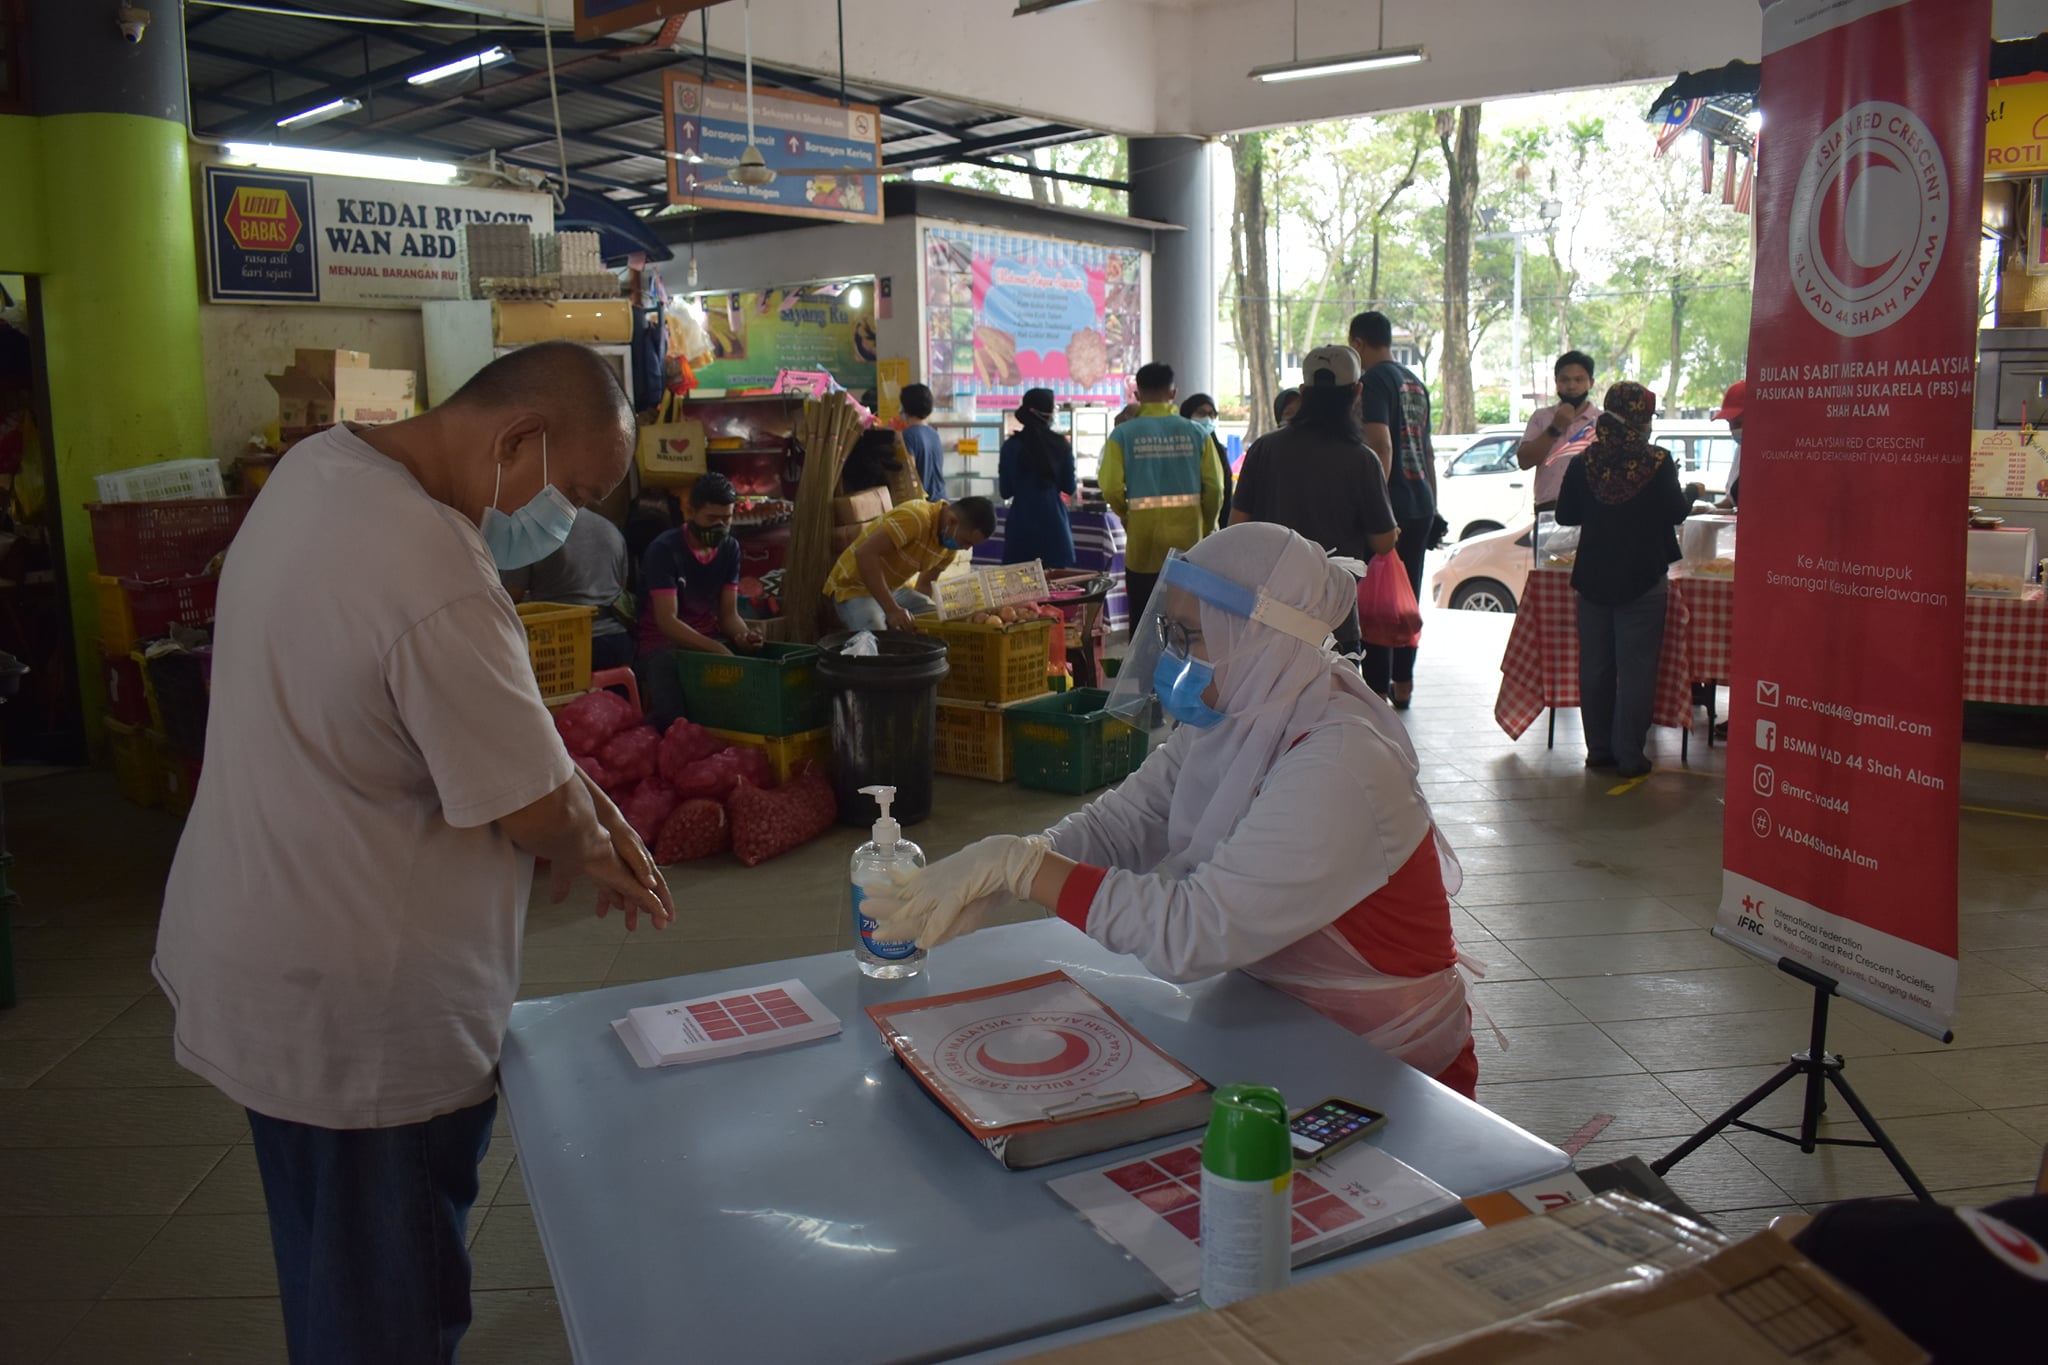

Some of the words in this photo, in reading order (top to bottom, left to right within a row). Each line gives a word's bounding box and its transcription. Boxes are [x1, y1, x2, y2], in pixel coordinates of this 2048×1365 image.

[731, 101, 760, 115] Mon
[701, 126, 747, 143] Barangan
[805, 141, 845, 157] Barangan
[846, 147, 873, 162] Kering
[1856, 112, 1883, 130] RED
[1887, 116, 1941, 202] CRESCENT
[1987, 144, 2042, 165] ROTI
[748, 185, 780, 200] Ringan
[337, 198, 427, 229] KEDAI
[325, 227, 392, 255] WAN
[400, 233, 457, 260] ABD
[244, 254, 267, 265] rasa
[269, 252, 288, 265] asli
[241, 265, 263, 278] kari
[265, 268, 292, 282] sejati
[328, 264, 379, 278] MENJUAL
[382, 268, 439, 281] BARANGAN
[1804, 279, 1834, 315] VAD
[1835, 309, 1849, 324] 44
[1851, 298, 1899, 326] SHAH
[1902, 234, 1939, 301] ALAM
[1759, 365, 1799, 382] BULAN
[1803, 363, 1839, 381] SABIT
[1841, 360, 1889, 378] MERAH
[1893, 356, 1970, 377] MALAYSIA
[1756, 387, 1804, 401] PASUKAN
[1807, 385, 1853, 399] BANTUAN
[1856, 382, 1923, 398] SUKARELA
[1927, 380, 1959, 399] (PBS)
[1961, 381, 1972, 395] 44
[1826, 404, 1850, 418] SHAH
[1852, 403, 1890, 417] ALAM
[1796, 436, 1844, 448] MALAYSIAN
[1846, 437, 1864, 449] RED
[1866, 437, 1926, 449] CRESCENT
[1760, 450, 1805, 461] VOLUNTARY
[1806, 451, 1821, 461] AID
[1869, 452, 1898, 464] (VAD)
[1901, 453, 1912, 463] 44
[1914, 453, 1939, 464] SHAH
[1940, 454, 1964, 465] ALAM
[1797, 554, 1814, 569] Ke
[1816, 557, 1840, 573] Arah
[1841, 561, 1913, 582] Memupuk
[1766, 570, 1827, 593] Semangat
[1829, 579, 1948, 607] Kesukarelawanan
[1785, 694, 1932, 737] mrc.vad44@gmail.com
[1783, 735, 1818, 757] BSMM
[1820, 746, 1842, 765] VAD
[1845, 755, 1863, 770] 44
[1867, 758, 1902, 780] Shah
[1905, 768, 1945, 791] Alam
[1780, 780, 1850, 815] @mrc.vad44
[1777, 823, 1879, 871] VAD44ShahAlam
[863, 919, 879, 929] アル
[1737, 914, 1765, 936] IFRC
[1773, 906, 1819, 933] International
[1819, 926, 1863, 951] Federation
[1783, 922, 1798, 938] Red
[1799, 929, 1818, 946] Cross
[1818, 938, 1835, 954] and
[1836, 943, 1853, 961] Red
[1854, 953, 1895, 976] Crescent
[1895, 969, 1935, 993] Societies
[1821, 955, 1845, 975] Saving
[1867, 974, 1909, 1000] Changing
[1908, 992, 1932, 1009] Minds
[1031, 1015, 1083, 1025] ALAM
[1084, 1020, 1116, 1041] SHAH
[952, 1018, 1011, 1050] MALAYSIA
[944, 1051, 967, 1078] MERAH
[966, 1074, 1008, 1090] SABIT
[1015, 1078, 1075, 1092] BULAN
